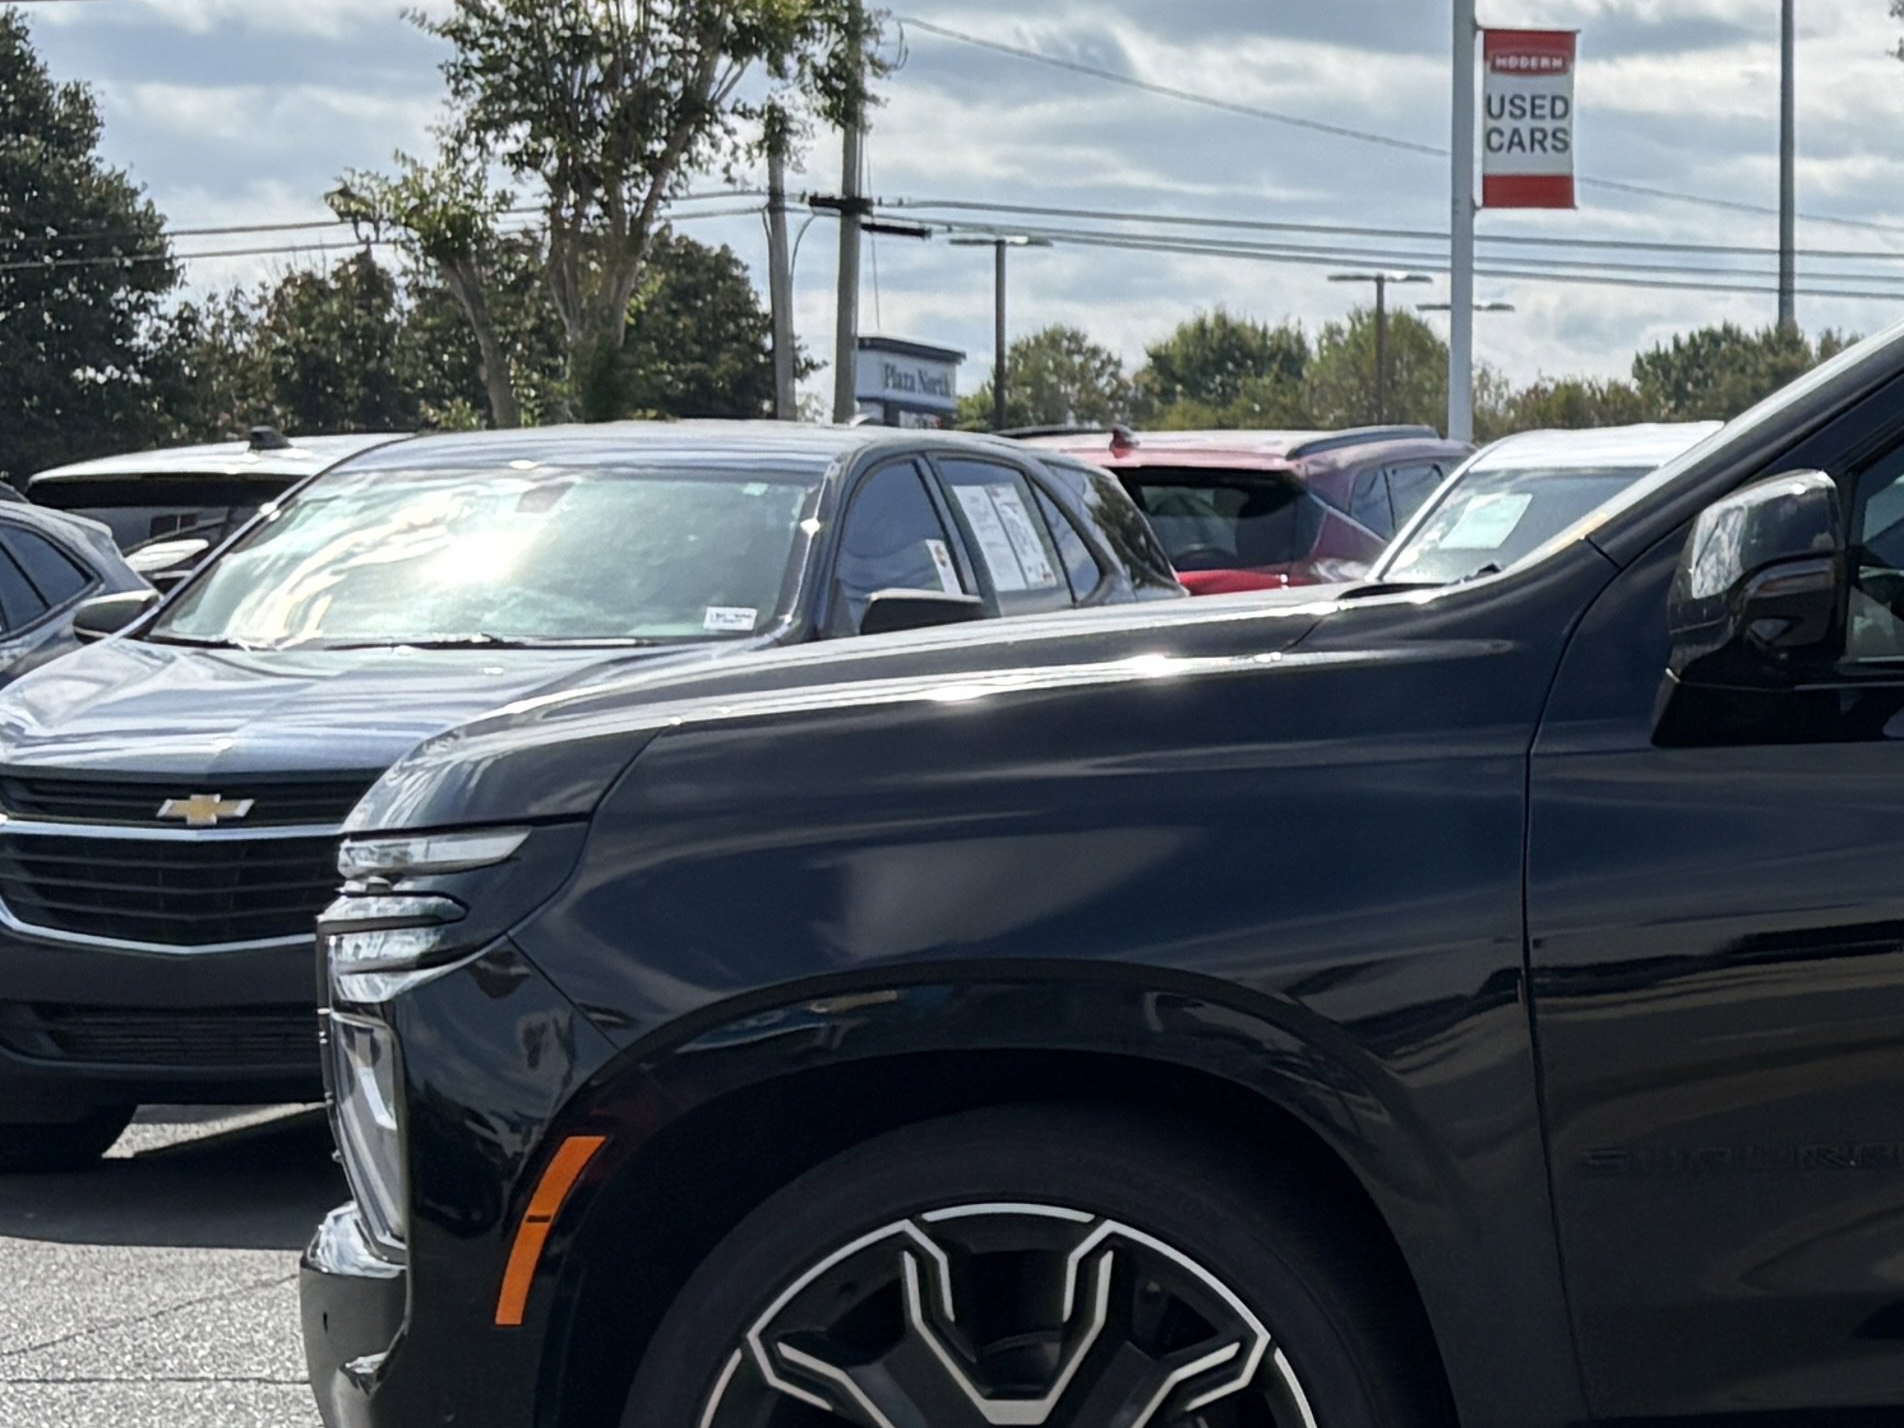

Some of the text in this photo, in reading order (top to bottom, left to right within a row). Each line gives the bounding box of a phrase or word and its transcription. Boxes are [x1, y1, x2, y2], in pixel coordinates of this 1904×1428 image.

[1495, 55, 1564, 70] MODERN
[1486, 94, 1570, 121] USED
[1485, 127, 1570, 154] CARS
